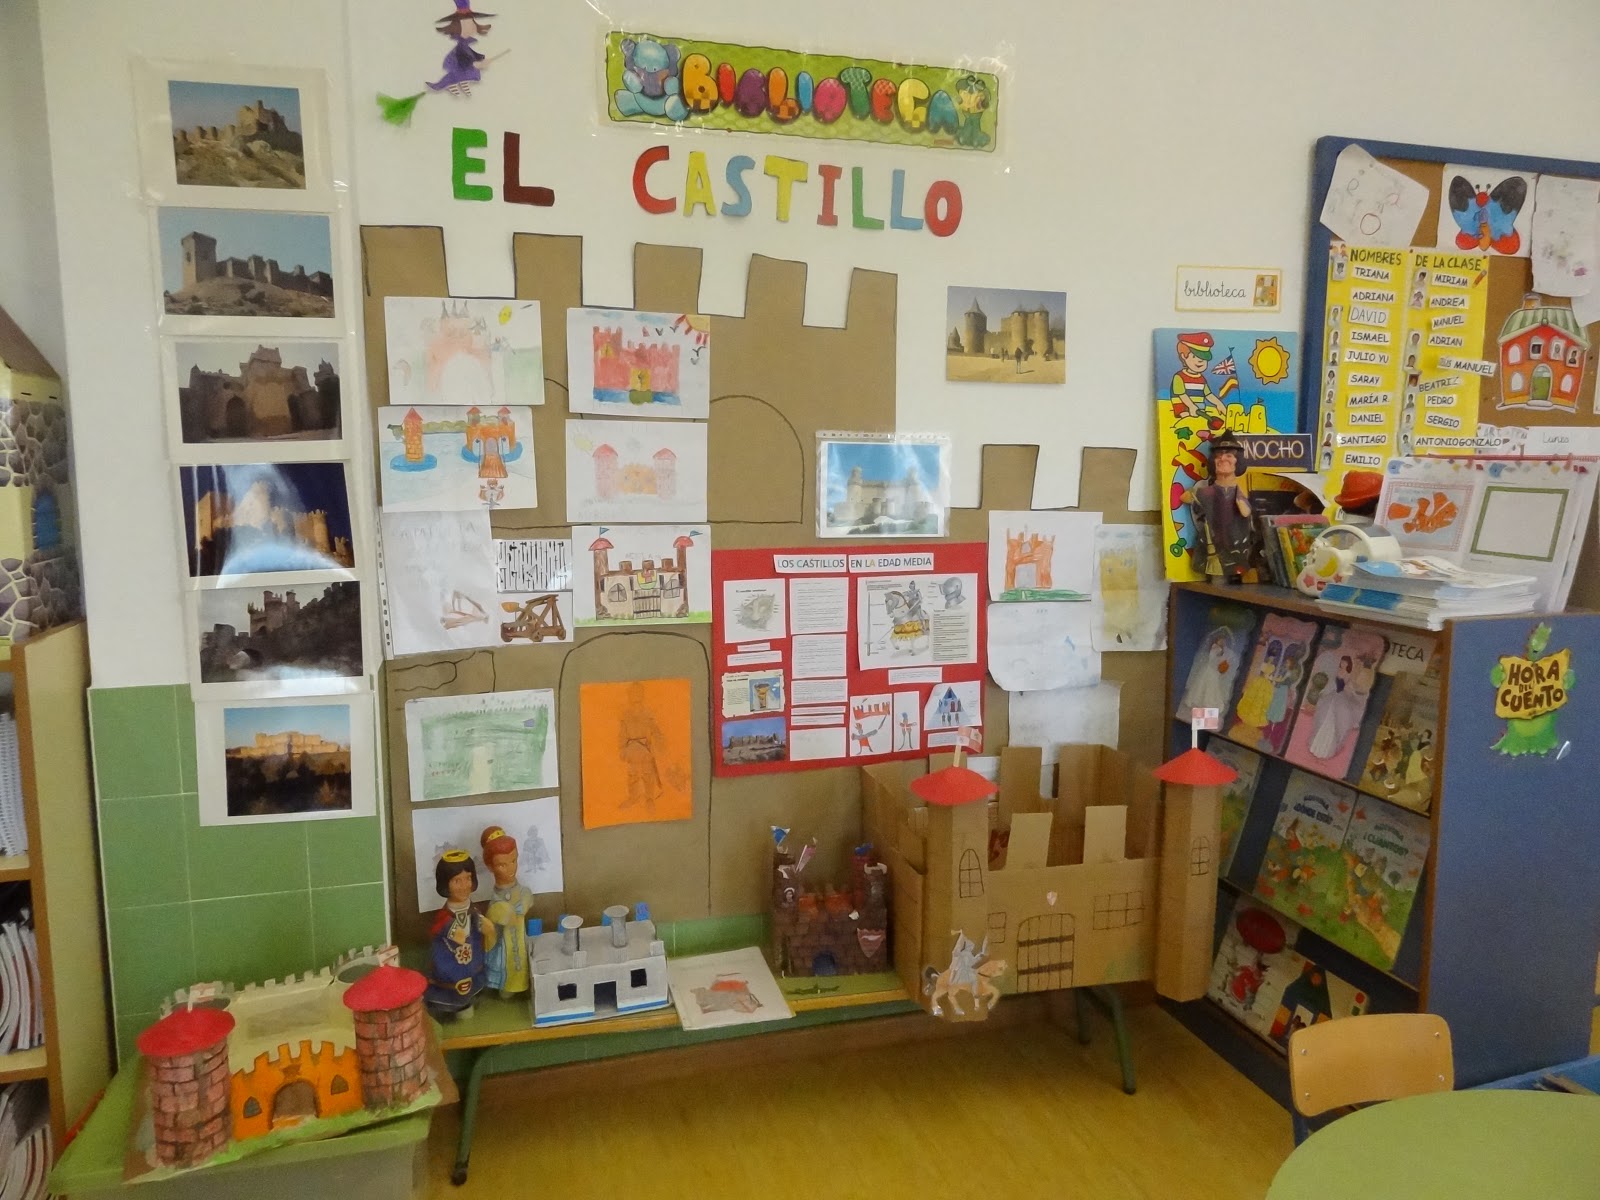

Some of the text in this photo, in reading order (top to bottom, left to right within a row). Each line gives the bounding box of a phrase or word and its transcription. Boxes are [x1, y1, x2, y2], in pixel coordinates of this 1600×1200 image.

[680, 52, 960, 135] BIBLIOTECA
[452, 127, 963, 237] EL CASTILLO
[1350, 249, 1482, 271] NOMBRES DE LA CLASE
[1354, 267, 1390, 280] TRIANA
[1435, 274, 1468, 286] MIRIAM
[1184, 280, 1246, 298] biblioteca
[1352, 291, 1394, 302] ADRIANA
[1431, 298, 1465, 307] ANDREA
[1350, 307, 1387, 324] DAVID
[1433, 315, 1464, 328] MANUEL
[1351, 331, 1389, 343] ISMAEL
[1429, 336, 1463, 346] ADRIAN
[1347, 350, 1389, 364] JULIO YU
[1453, 361, 1493, 374] MANUEL
[1350, 374, 1380, 385] SARAY
[1418, 376, 1460, 392] BEATRIZ
[1349, 394, 1379, 406] MARÍA
[1427, 396, 1454, 405] PEDRO
[1350, 413, 1384, 423] DANIEL
[1426, 415, 1460, 428] SERGIO
[1340, 435, 1386, 445] SANTIAGO
[1237, 440, 1304, 460] INOCHO
[1345, 454, 1381, 466] EMILIO
[777, 556, 931, 569] LOS CASTILLOS EN LA EDAD MEDIA
[1387, 641, 1424, 662] TECA
[1508, 659, 1560, 685] HORA
[1501, 685, 1563, 712] CUENTO
